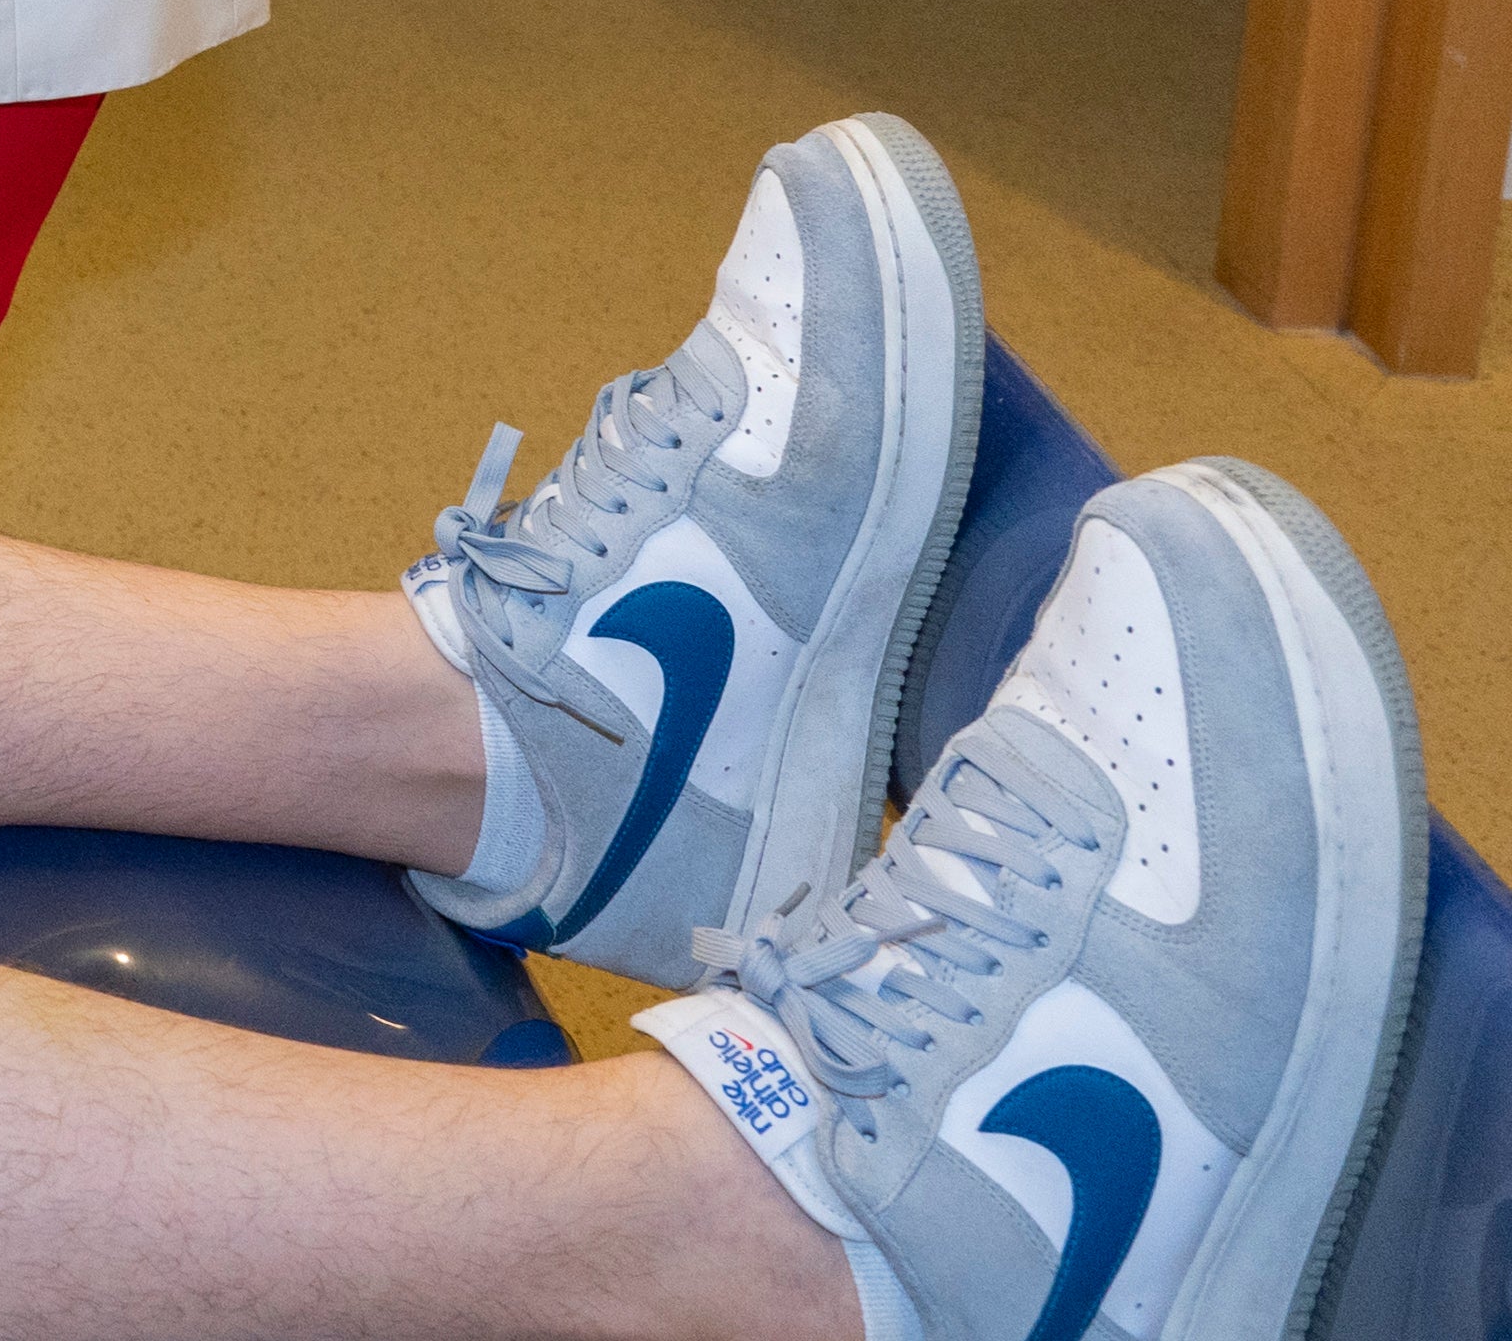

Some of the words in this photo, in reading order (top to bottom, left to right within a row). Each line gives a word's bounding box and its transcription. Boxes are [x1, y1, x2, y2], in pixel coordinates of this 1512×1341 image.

[709, 1030, 791, 1118] athletic
[757, 1048, 809, 1107] club
[722, 1080, 772, 1134] nike
